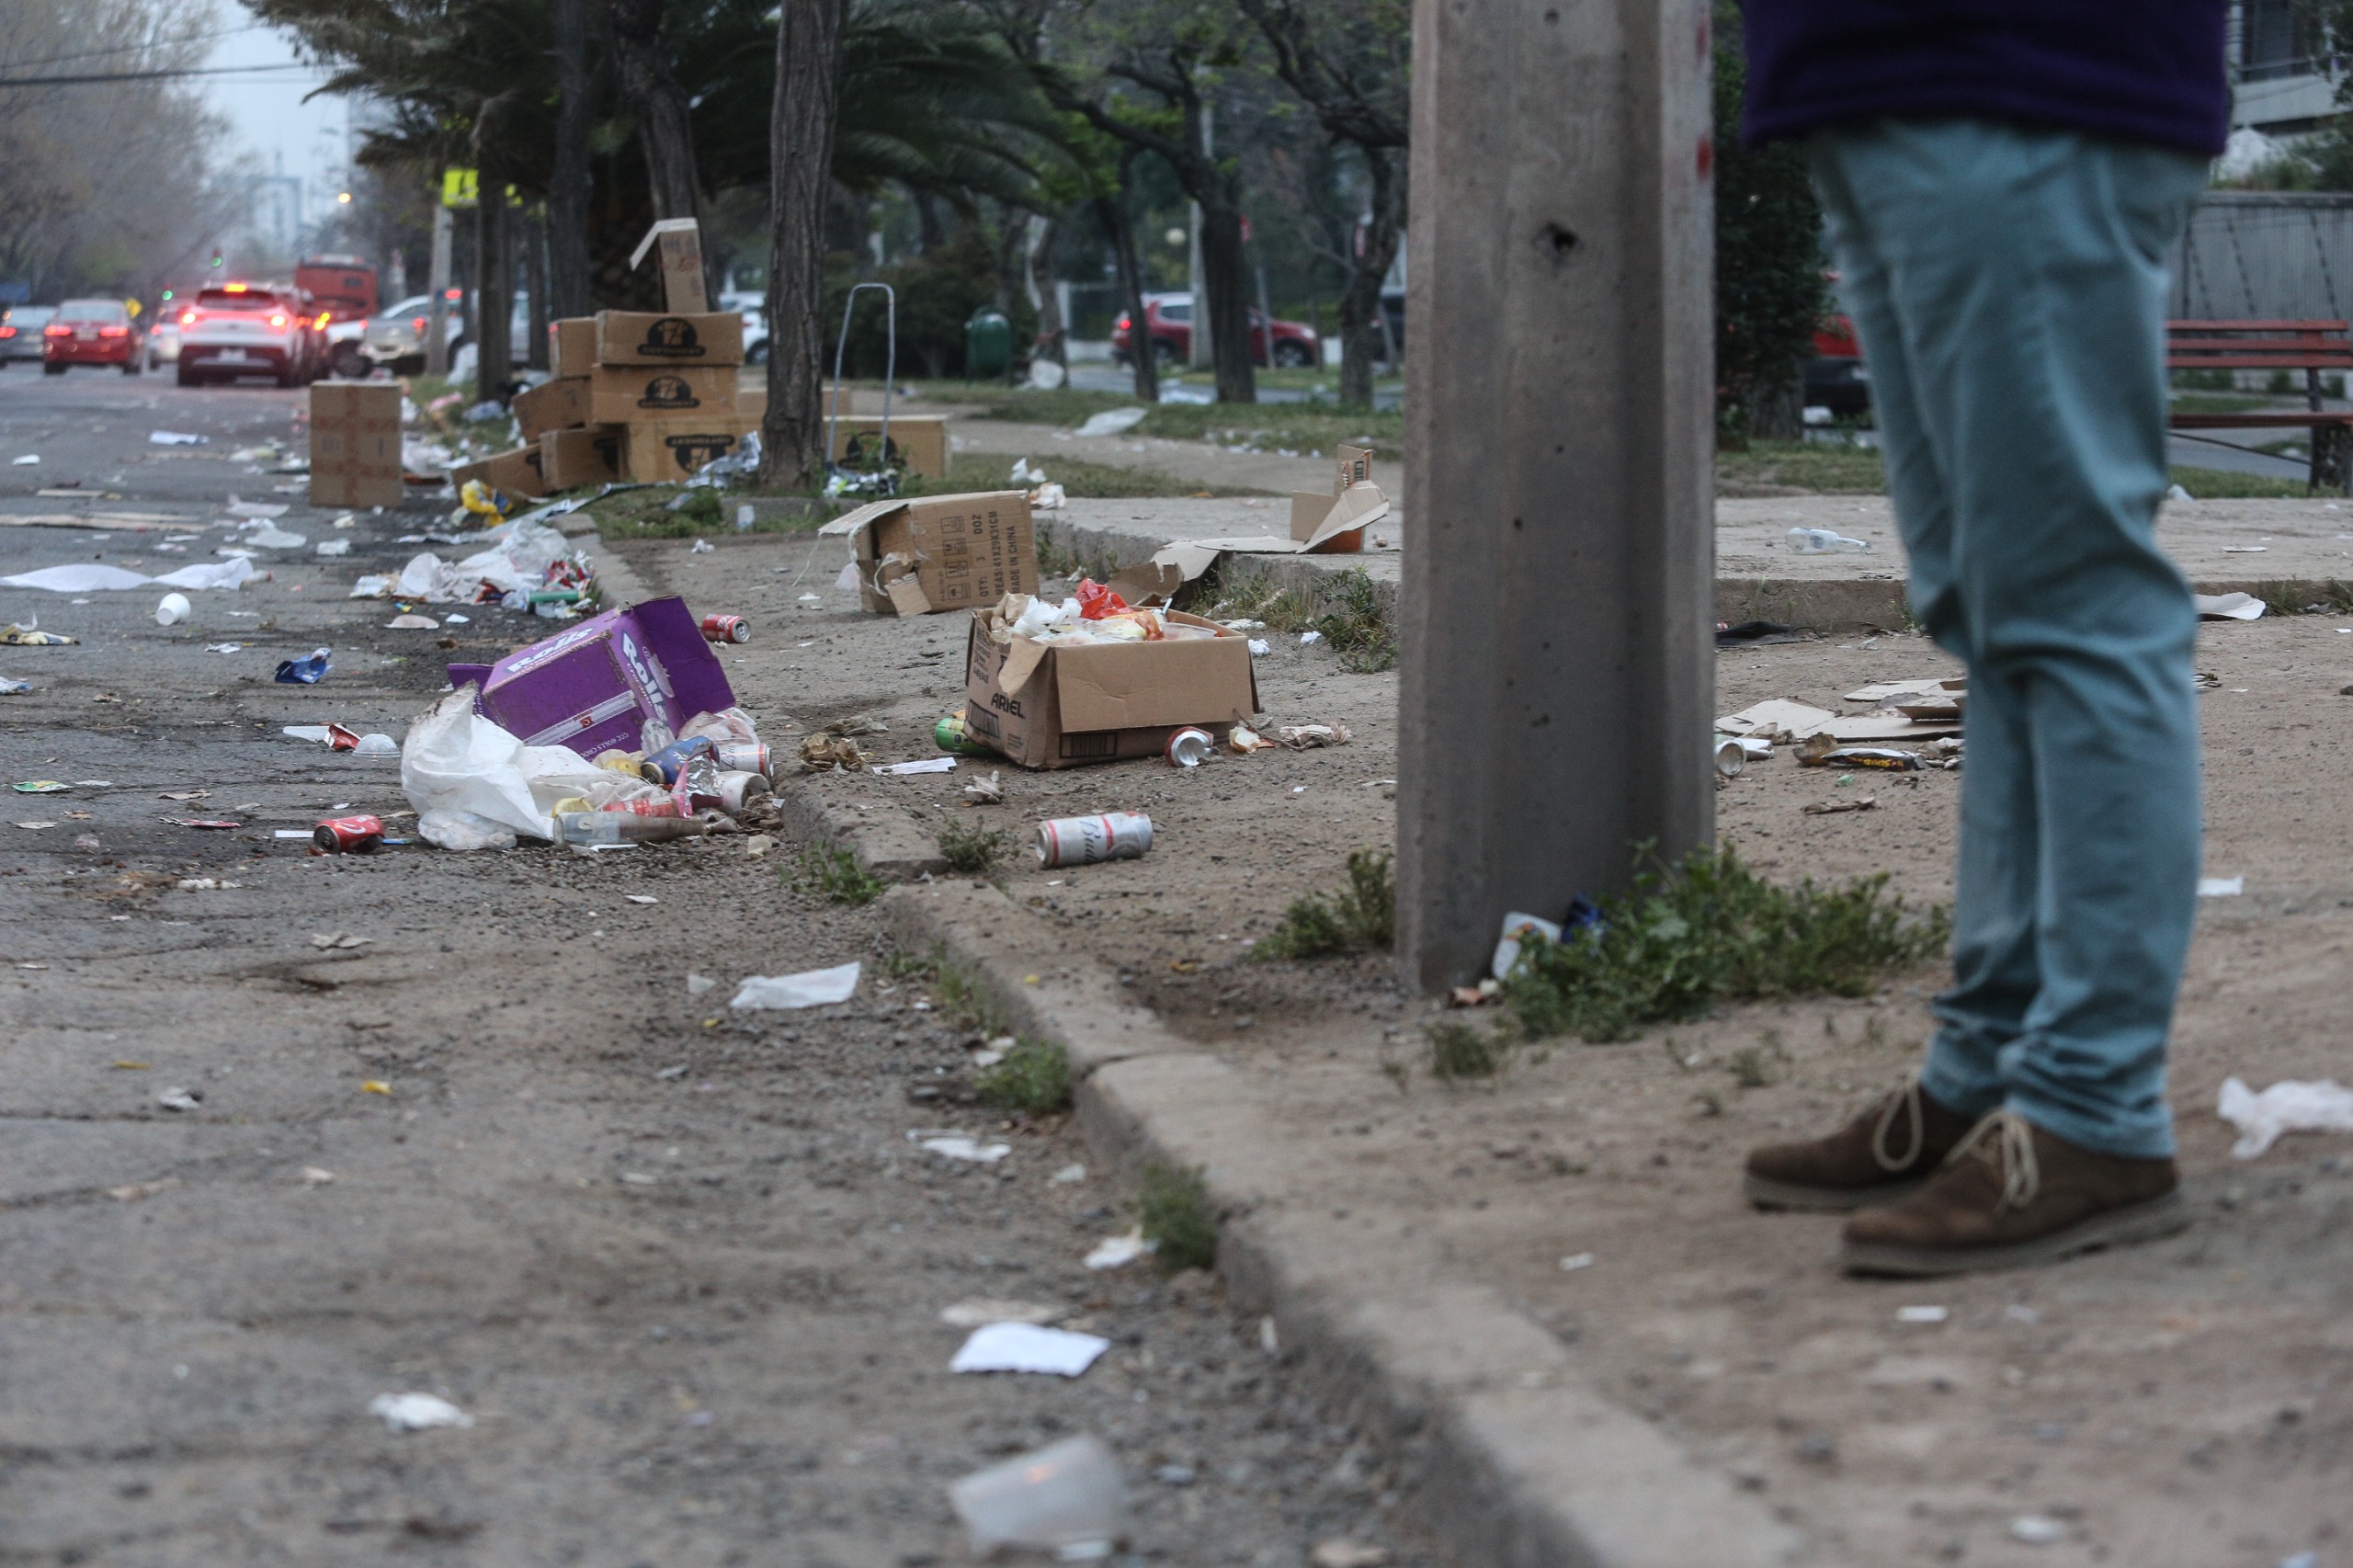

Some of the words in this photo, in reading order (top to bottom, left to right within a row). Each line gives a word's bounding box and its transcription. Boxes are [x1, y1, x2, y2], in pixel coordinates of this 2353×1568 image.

[972, 514, 983, 535] DOZ
[1006, 525, 1018, 554] CHINA
[1009, 557, 1018, 566] IN
[978, 576, 989, 597] QTY:
[1010, 569, 1021, 595] MADE
[506, 628, 594, 673] Rolls
[621, 632, 668, 724] Rolls
[991, 693, 1025, 719] ARIEL
[598, 737, 618, 749] ROLLS
